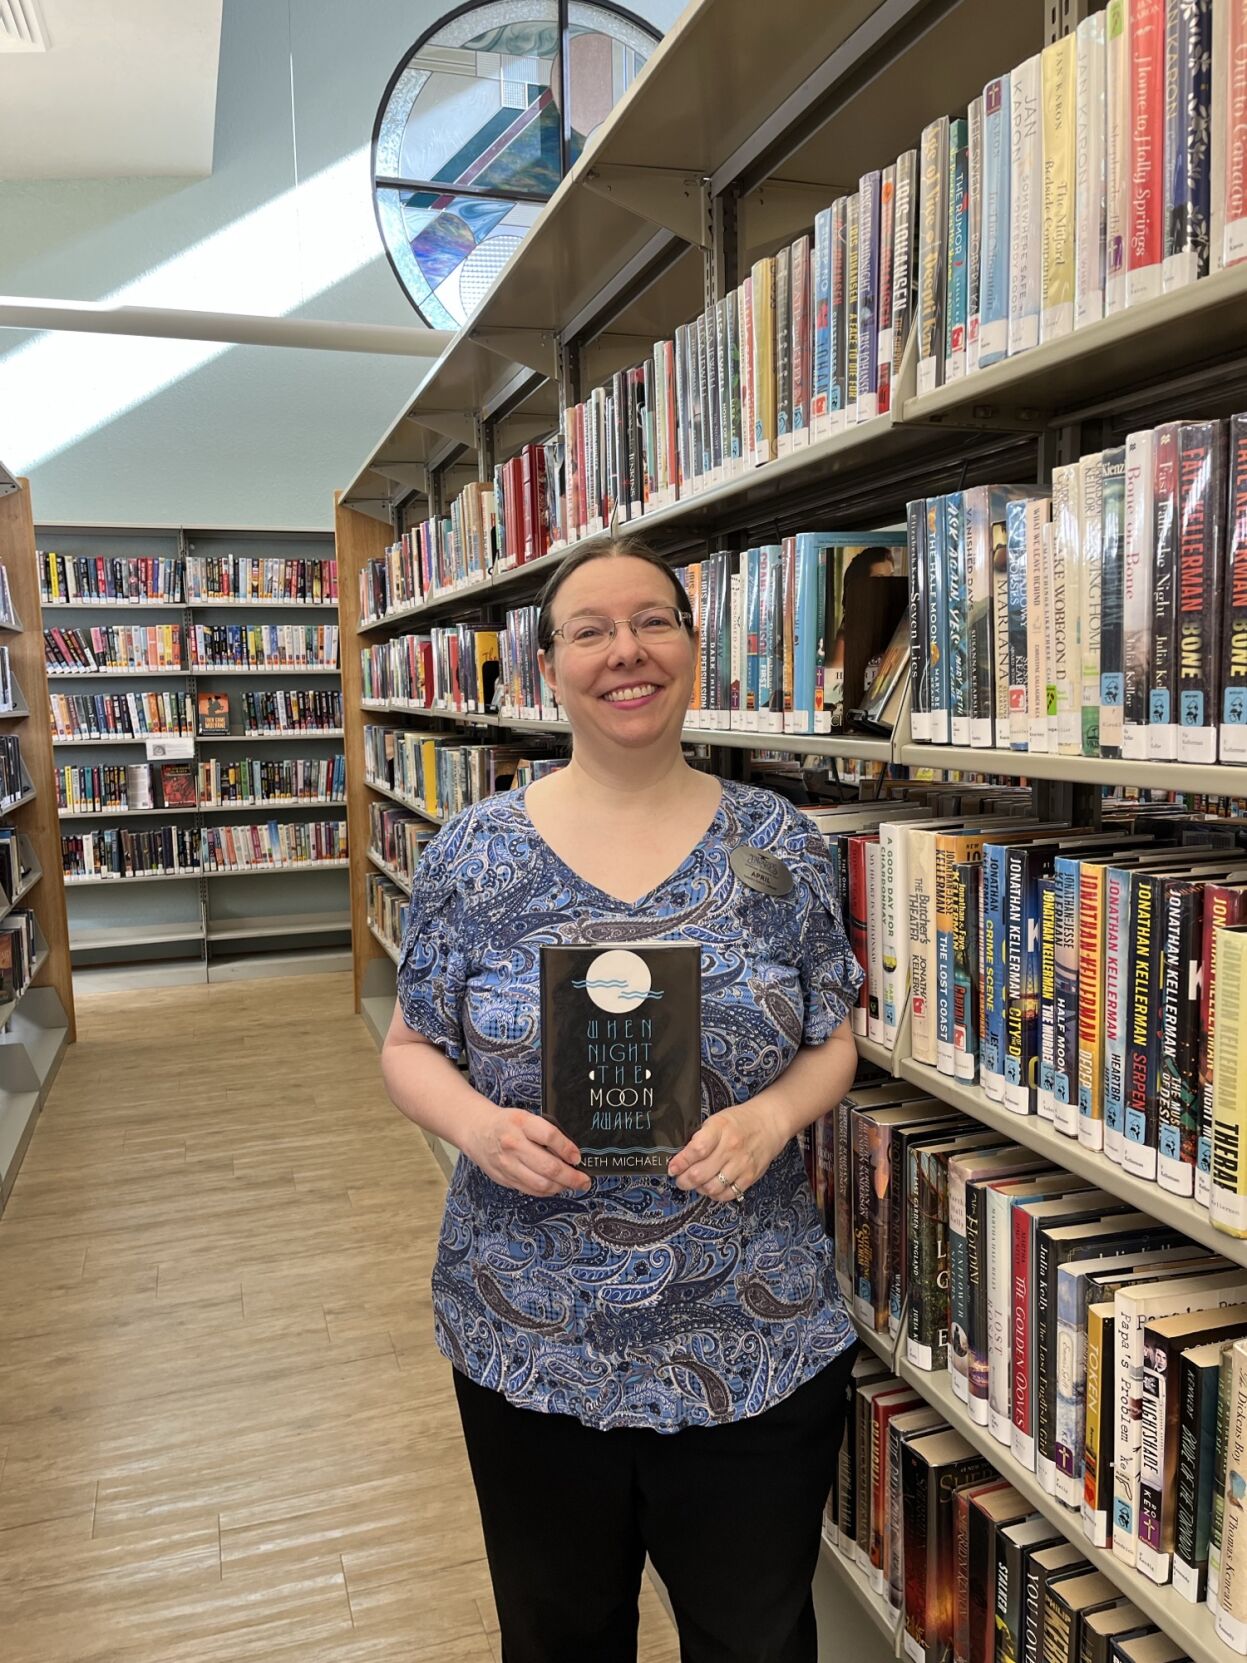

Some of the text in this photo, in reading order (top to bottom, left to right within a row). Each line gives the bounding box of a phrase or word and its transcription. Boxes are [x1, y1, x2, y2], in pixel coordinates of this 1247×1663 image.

[1053, 83, 1064, 130] KARON
[1133, 51, 1152, 109] Home
[1167, 34, 1179, 119] KARON
[1011, 80, 1023, 164] KARON
[1023, 96, 1038, 139] JAN
[1077, 103, 1089, 186] KARON
[1136, 114, 1149, 131] to
[924, 126, 940, 227] Age Vice
[1133, 131, 1152, 183] Holly
[1230, 123, 1247, 217] Canaan
[893, 179, 910, 312] IRIS JOHANSEN
[954, 172, 964, 256] THE RUMOR
[1042, 159, 1055, 301] Bedside Companion
[1132, 189, 1150, 257] Springs
[848, 223, 858, 398] IRIS JOHANSEN FACE DIE FOR
[859, 331, 870, 352] IRIS
[698, 354, 707, 398] JEWELL
[706, 317, 715, 389] LISA JEWELL
[716, 310, 725, 393] LISA JEWELL
[1085, 467, 1096, 512] KEILLOR
[929, 531, 938, 558] THE
[966, 508, 975, 575] VANISHED
[1032, 507, 1041, 606] WHAT LEAVE BEHIND
[1154, 461, 1174, 666] Fast Night Julia
[1180, 448, 1206, 679] FAYE KELLERMAN BONE
[929, 562, 938, 598] HALF
[947, 502, 965, 714] ASK AGAIN, YES MARY BETH
[967, 578, 975, 611] DAYS
[1124, 464, 1142, 707] Bone Bone Julia Keller
[700, 580, 709, 708] IRIS JOHANSEN PERSUASION
[910, 590, 922, 678] Seven Lies
[929, 602, 938, 645] MOON
[997, 579, 1010, 681] MARIANA
[1053, 583, 1068, 665] WOBEGON
[1088, 603, 1101, 654] HOME
[1230, 619, 1247, 677] BONE
[760, 664, 769, 688] FIRST
[1015, 655, 1023, 685] KEAR
[751, 871, 771, 884] APRIL
[880, 846, 888, 925] CHARDONNAY
[887, 836, 896, 938] A GOOD DAY FOR
[914, 878, 924, 893] THE
[935, 849, 945, 914] KELLERMAN
[944, 850, 955, 915] JONATHAN JESSE
[982, 852, 990, 915] KELLERMAN
[990, 857, 999, 912] JONATHAN
[909, 893, 919, 942] THEATER
[918, 893, 931, 945] Butcher's
[952, 871, 960, 950] KELLERMAN
[955, 883, 967, 950] Jonathan Faye
[1063, 872, 1075, 949] JONATHAN JESSE
[912, 954, 920, 996] KELLERM
[985, 919, 995, 1012] CRIME SCENE
[1008, 857, 1022, 1036] JONATHAN KELLERMAN CITY
[1041, 889, 1055, 1024] JONATHAN KELLERMAN THE
[1163, 888, 1183, 1058] JONATHAN KELLERMAN
[938, 936, 949, 1040] THE LOST COAST
[954, 986, 966, 1019] CAPITAL
[1079, 874, 1099, 1088] JONATHAN KELLERMAN DECEP
[1106, 878, 1122, 1102] JONATHAN KELLERMAN HEARTBR
[1131, 882, 1153, 1111] JONATHAN KELLERMAN SERPEN
[587, 1019, 653, 1039] WHEN
[1056, 998, 1067, 1032] HALF
[1218, 939, 1242, 1111] JONATHAN KELLERMAN
[588, 1043, 653, 1063] NIGHT
[596, 1065, 643, 1085] THE
[1162, 1072, 1171, 1086] OF
[590, 1088, 654, 1108] MOON
[590, 1110, 652, 1131] AWAKES
[1170, 1076, 1182, 1126] THE MUS
[580, 1155, 673, 1168] NETH MICHAEL K
[857, 1117, 867, 1216] BRANDON SANDERSON
[862, 1166, 871, 1205] JORDAN
[891, 1138, 901, 1270] ROBERT JORDAN
[855, 1228, 864, 1266] STORM
[912, 1176, 920, 1331] LAST GARDEN ENGLAND JULIA
[994, 1309, 1003, 1356] LOST
[1013, 1275, 1027, 1428] THE GOLDEN DOVES
[1035, 1244, 1049, 1456] Julia Kelly The Lost English Girl
[1088, 1343, 1099, 1415] TOKEN
[1119, 1312, 1132, 1442] Papa's Problem
[1185, 1369, 1197, 1419] KENNEDY
[1142, 1398, 1159, 1473] NIGHTSHADE
[1181, 1424, 1198, 1463] BRIDE
[1235, 1392, 1247, 1441] Dickens
[1180, 1463, 1196, 1483] OF
[1231, 1441, 1244, 1466] Boy
[1179, 1483, 1195, 1507] THE
[1178, 1506, 1194, 1561] TORNADO
[1225, 1511, 1238, 1563] Thomas
[997, 1561, 1009, 1614] STALKER
[1026, 1572, 1039, 1614] YOU
[1221, 1564, 1237, 1613] Keneally
